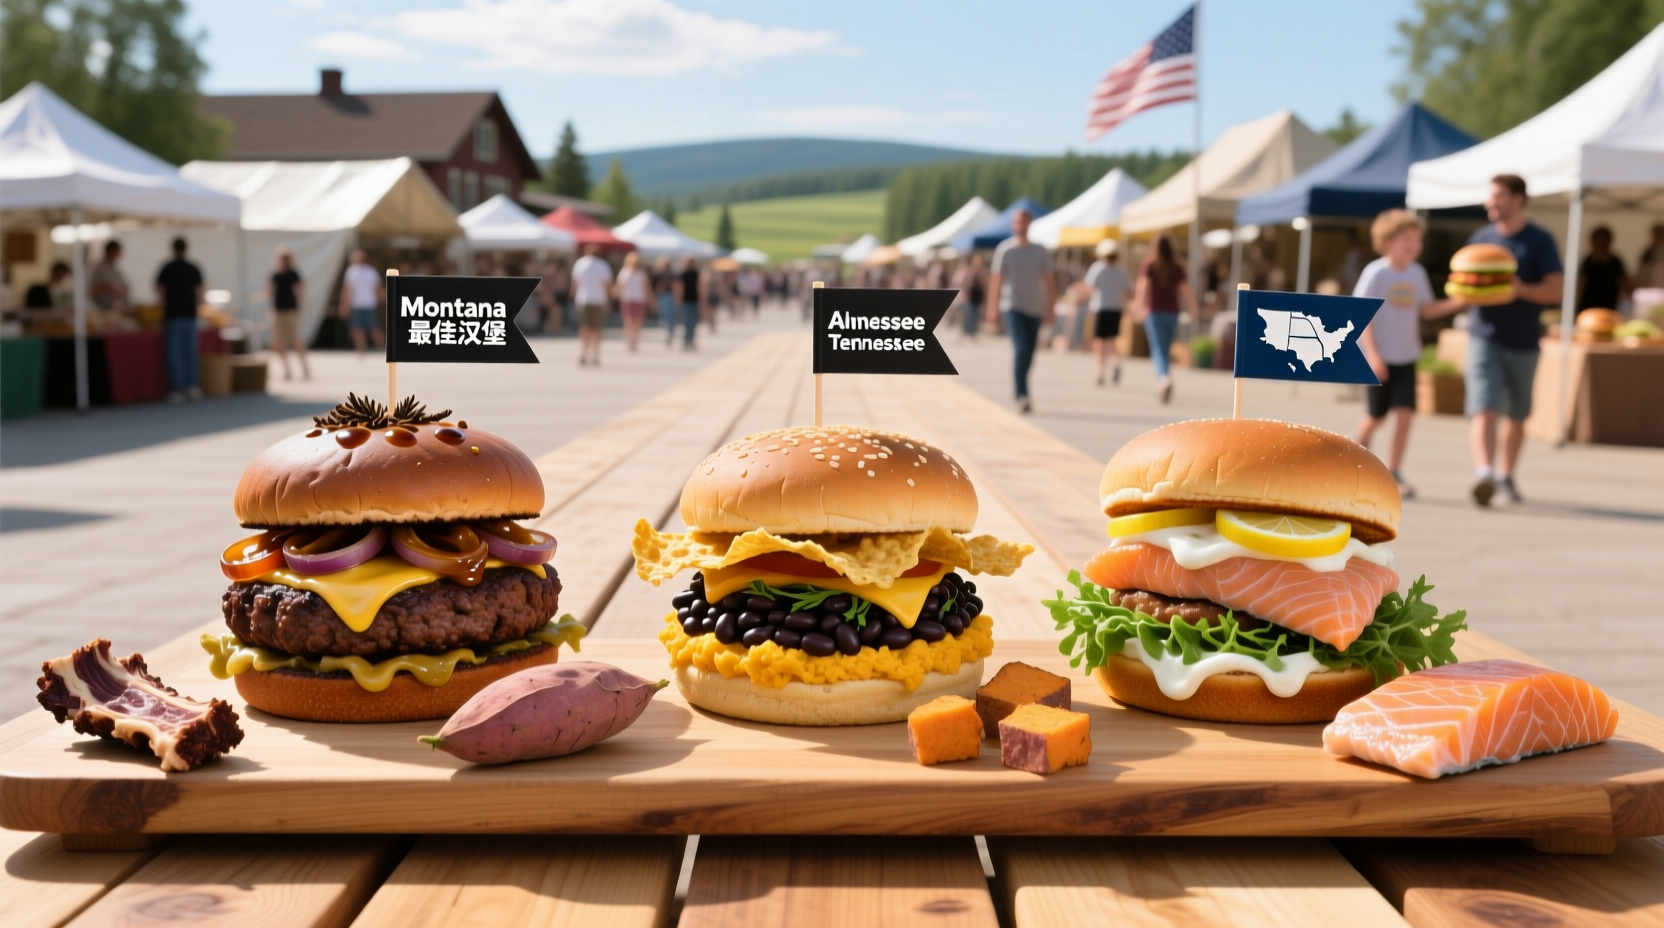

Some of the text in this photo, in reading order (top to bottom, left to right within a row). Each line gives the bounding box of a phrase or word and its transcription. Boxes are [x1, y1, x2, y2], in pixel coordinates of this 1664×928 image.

[401, 296, 506, 317] Montana
[408, 320, 506, 345] 最佳汉堡
[828, 334, 925, 351] Tennessee
